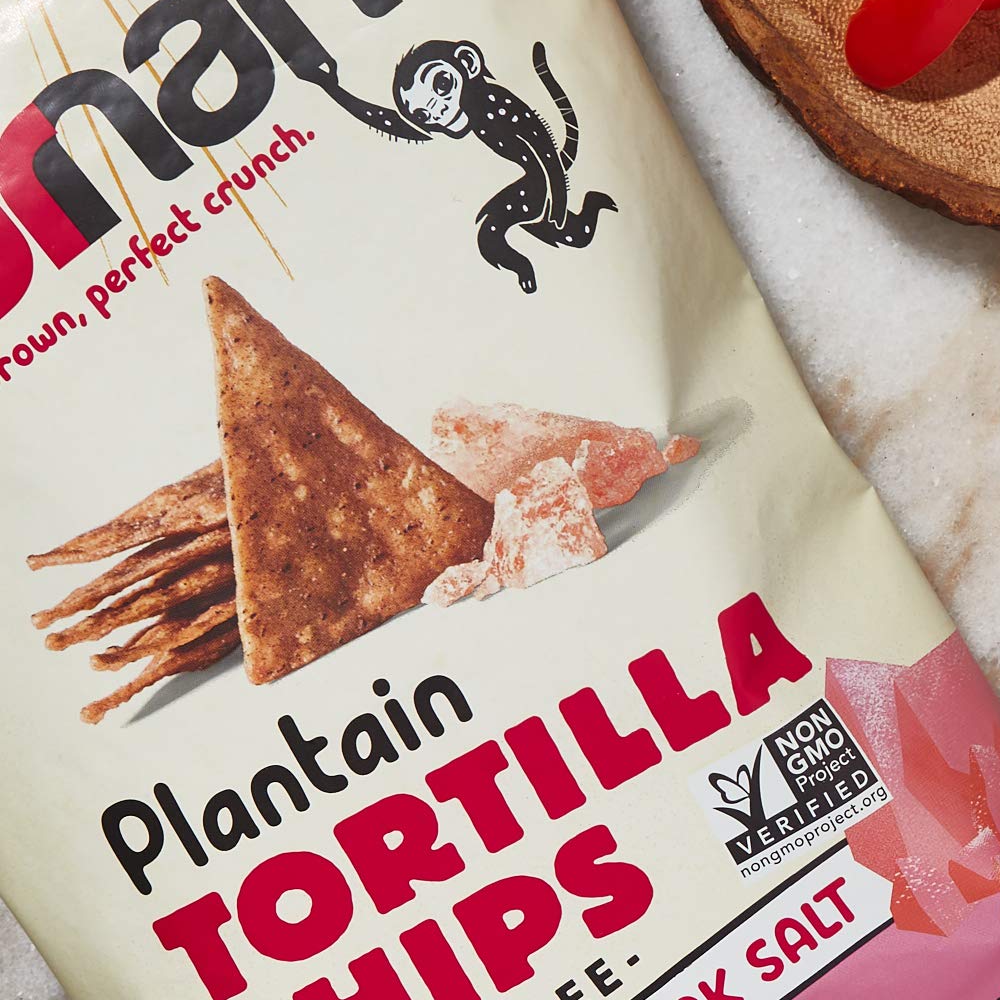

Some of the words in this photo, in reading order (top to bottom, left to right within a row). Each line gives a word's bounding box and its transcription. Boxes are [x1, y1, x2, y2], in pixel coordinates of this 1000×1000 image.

[85, 204, 202, 320] perfect
[203, 123, 315, 215] crunch.
[774, 707, 833, 757] NON
[786, 728, 845, 775] GMO
[795, 747, 857, 793] Project
[101, 675, 473, 895] Plantain
[152, 591, 813, 1000] TORTILLA
[736, 769, 869, 855] VERIFIED
[740, 785, 888, 878] nongmoproject.org
[746, 876, 855, 982] SALT
